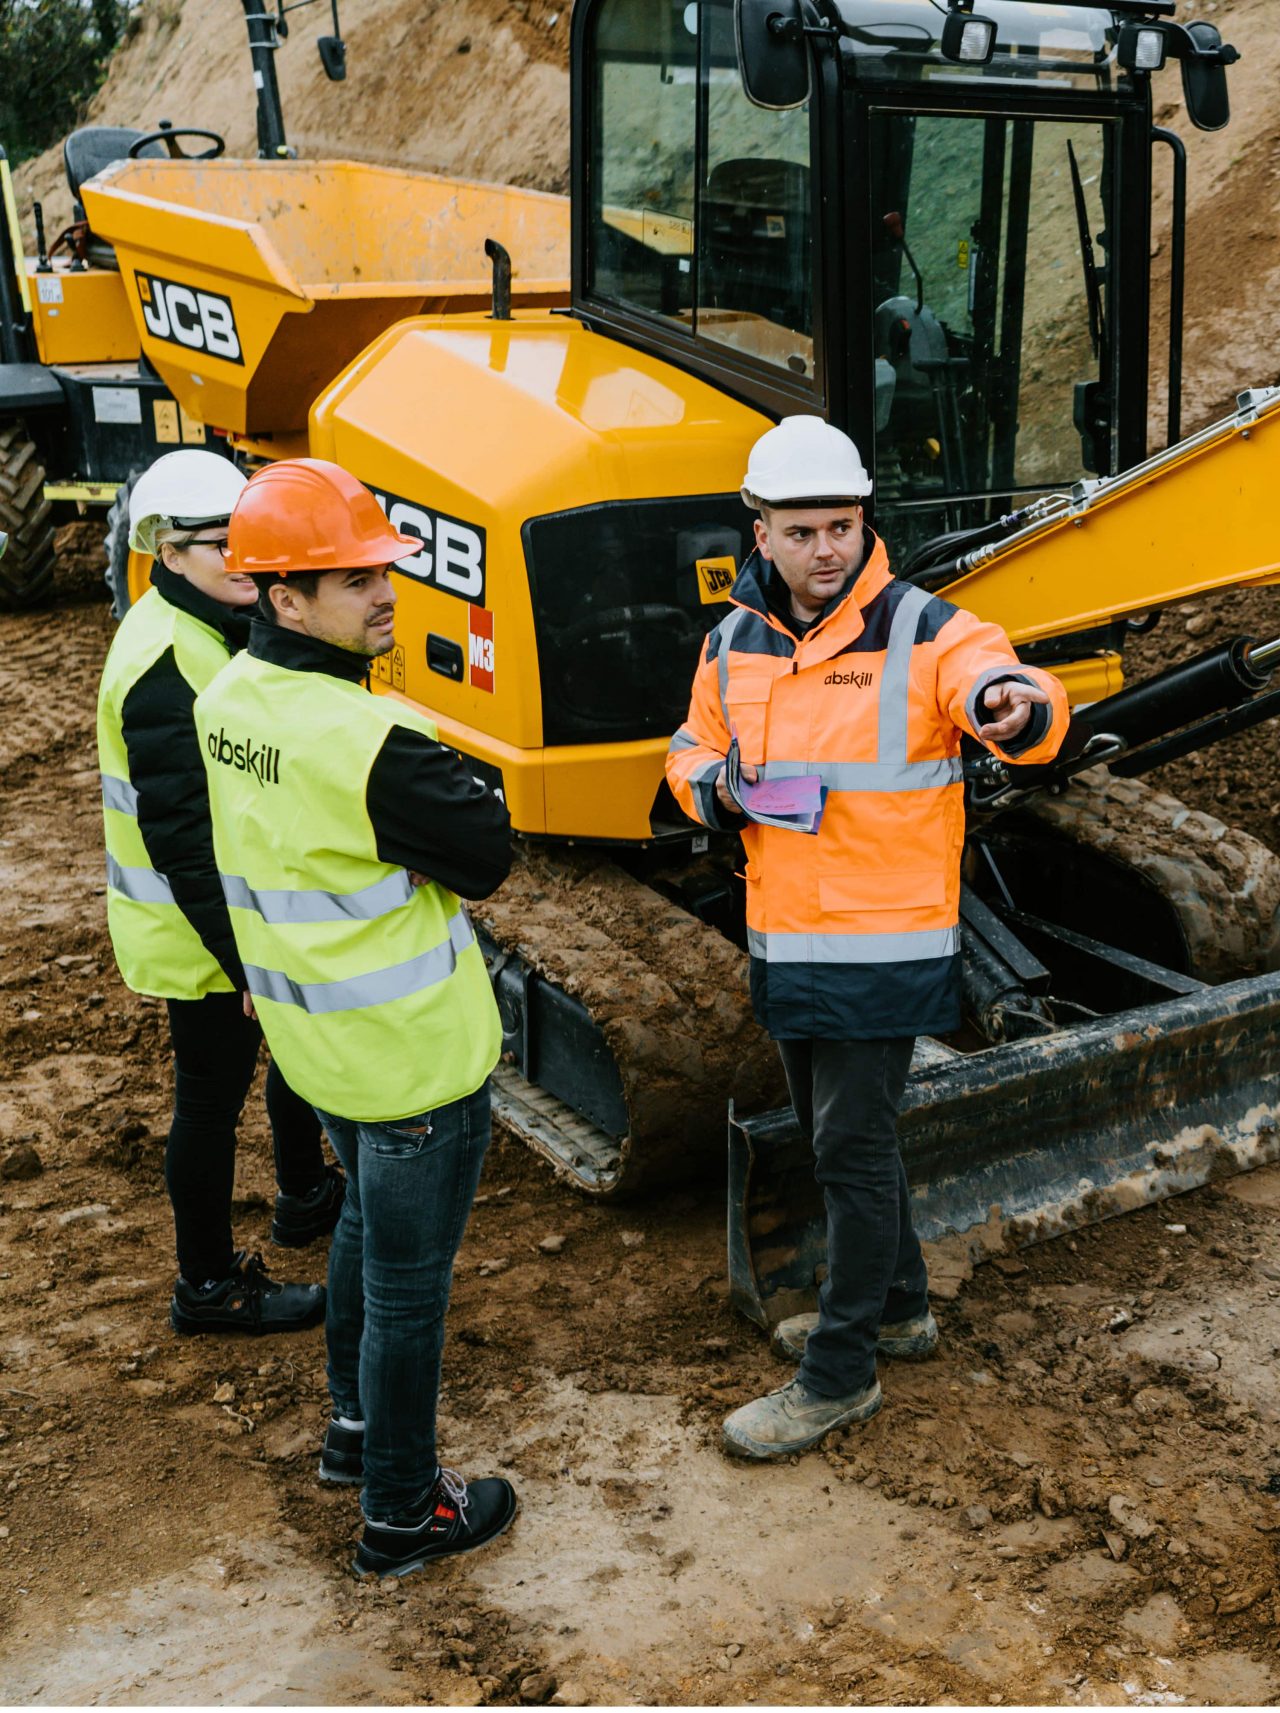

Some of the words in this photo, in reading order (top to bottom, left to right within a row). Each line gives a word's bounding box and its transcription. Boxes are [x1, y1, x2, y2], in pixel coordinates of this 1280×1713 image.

[143, 280, 240, 359] JCB
[375, 493, 483, 597] CB
[706, 569, 732, 591] JCB
[469, 632, 495, 673] M3
[824, 671, 873, 689] abskill
[208, 727, 280, 789] abskill
